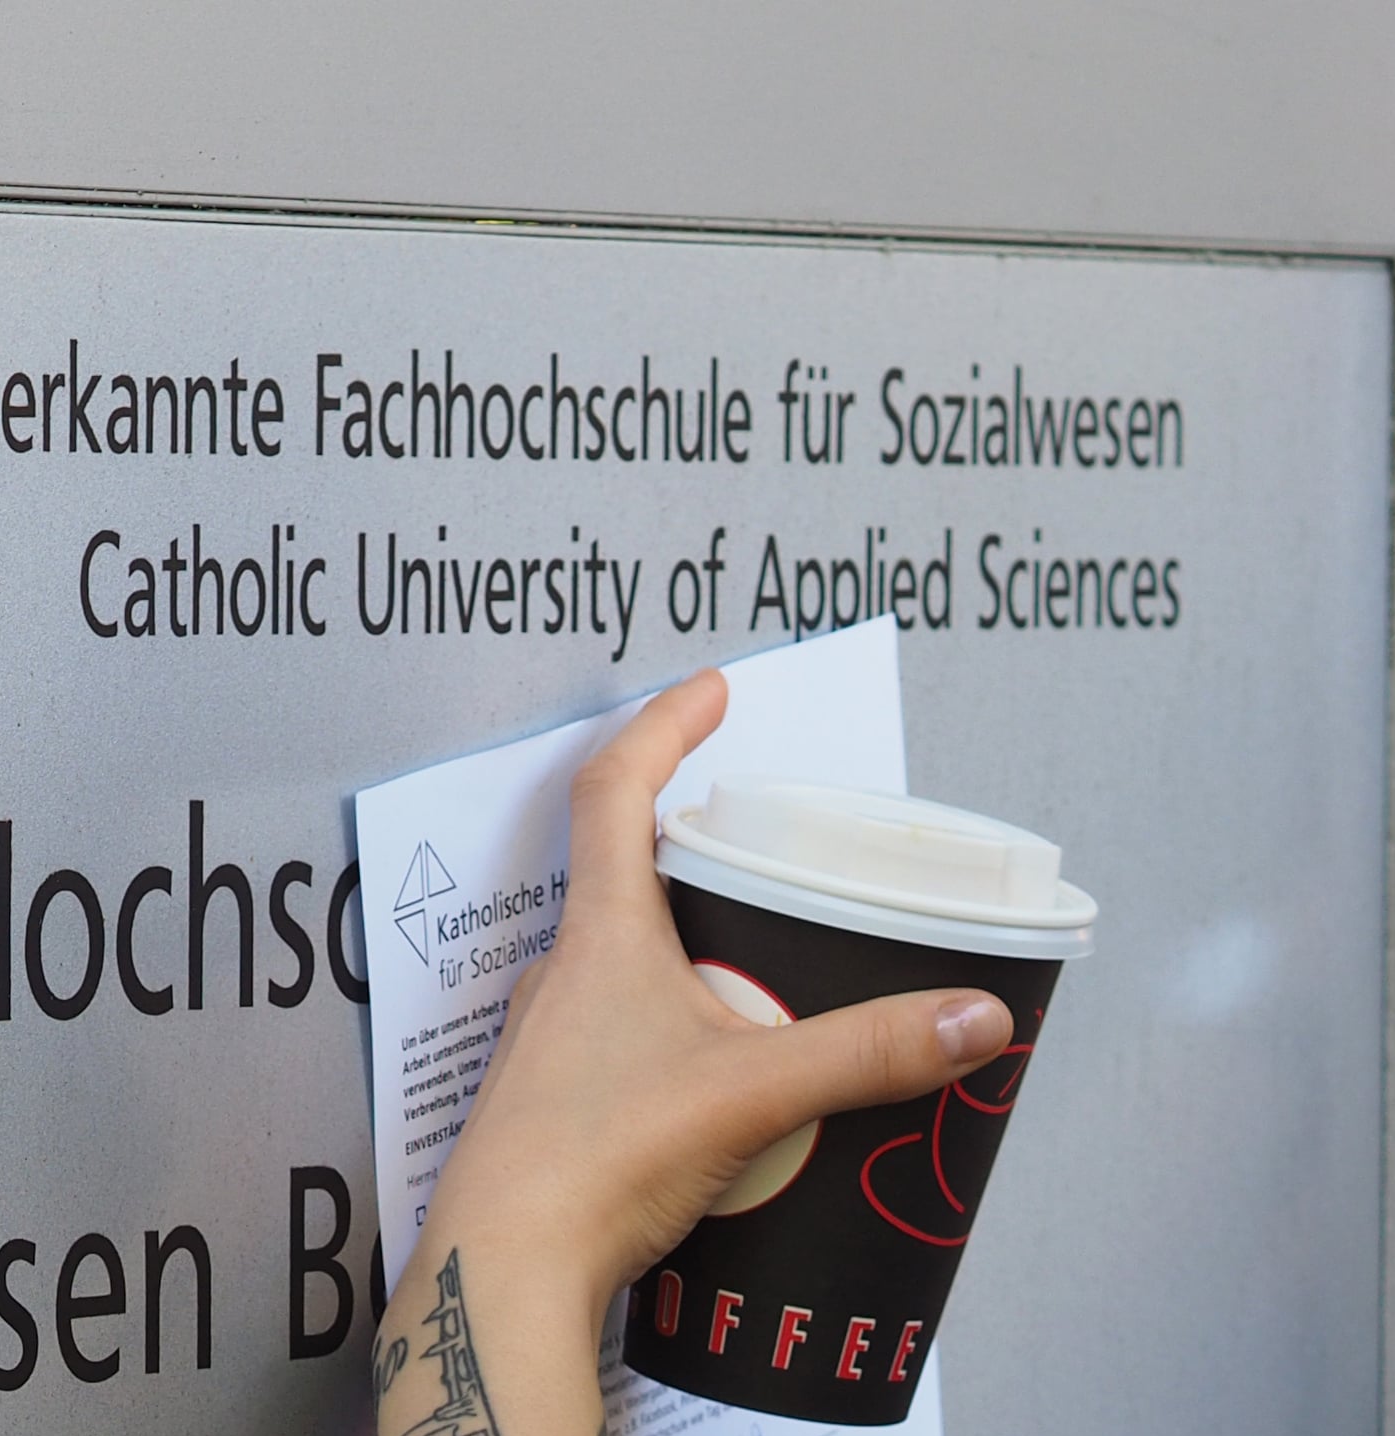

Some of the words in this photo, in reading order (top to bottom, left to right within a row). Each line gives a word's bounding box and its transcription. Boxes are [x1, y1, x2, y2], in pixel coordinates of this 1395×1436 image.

[316, 349, 751, 463] Fachhochschule
[778, 358, 855, 464] für
[881, 364, 1184, 468] Sozialwesen
[80, 524, 326, 638] Catholic
[357, 526, 642, 662] University
[668, 527, 725, 633] of
[749, 527, 953, 642] Applied
[978, 527, 1182, 631] Sciences
[437, 882, 545, 945] Katholische
[551, 869, 569, 902] H
[438, 958, 464, 991] für
[470, 925, 557, 979] Sozialwes
[401, 1036, 417, 1051] Um
[419, 1027, 439, 1044] über
[441, 1015, 468, 1035] unsere
[471, 1000, 500, 1021] Arbeit
[403, 1053, 431, 1075] Arbeit
[457, 1057, 482, 1076] Unter
[405, 1119, 466, 1156] EINVERSTÄN
[289, 1166, 387, 1360] B
[631, 1269, 924, 1383] OFFEE
